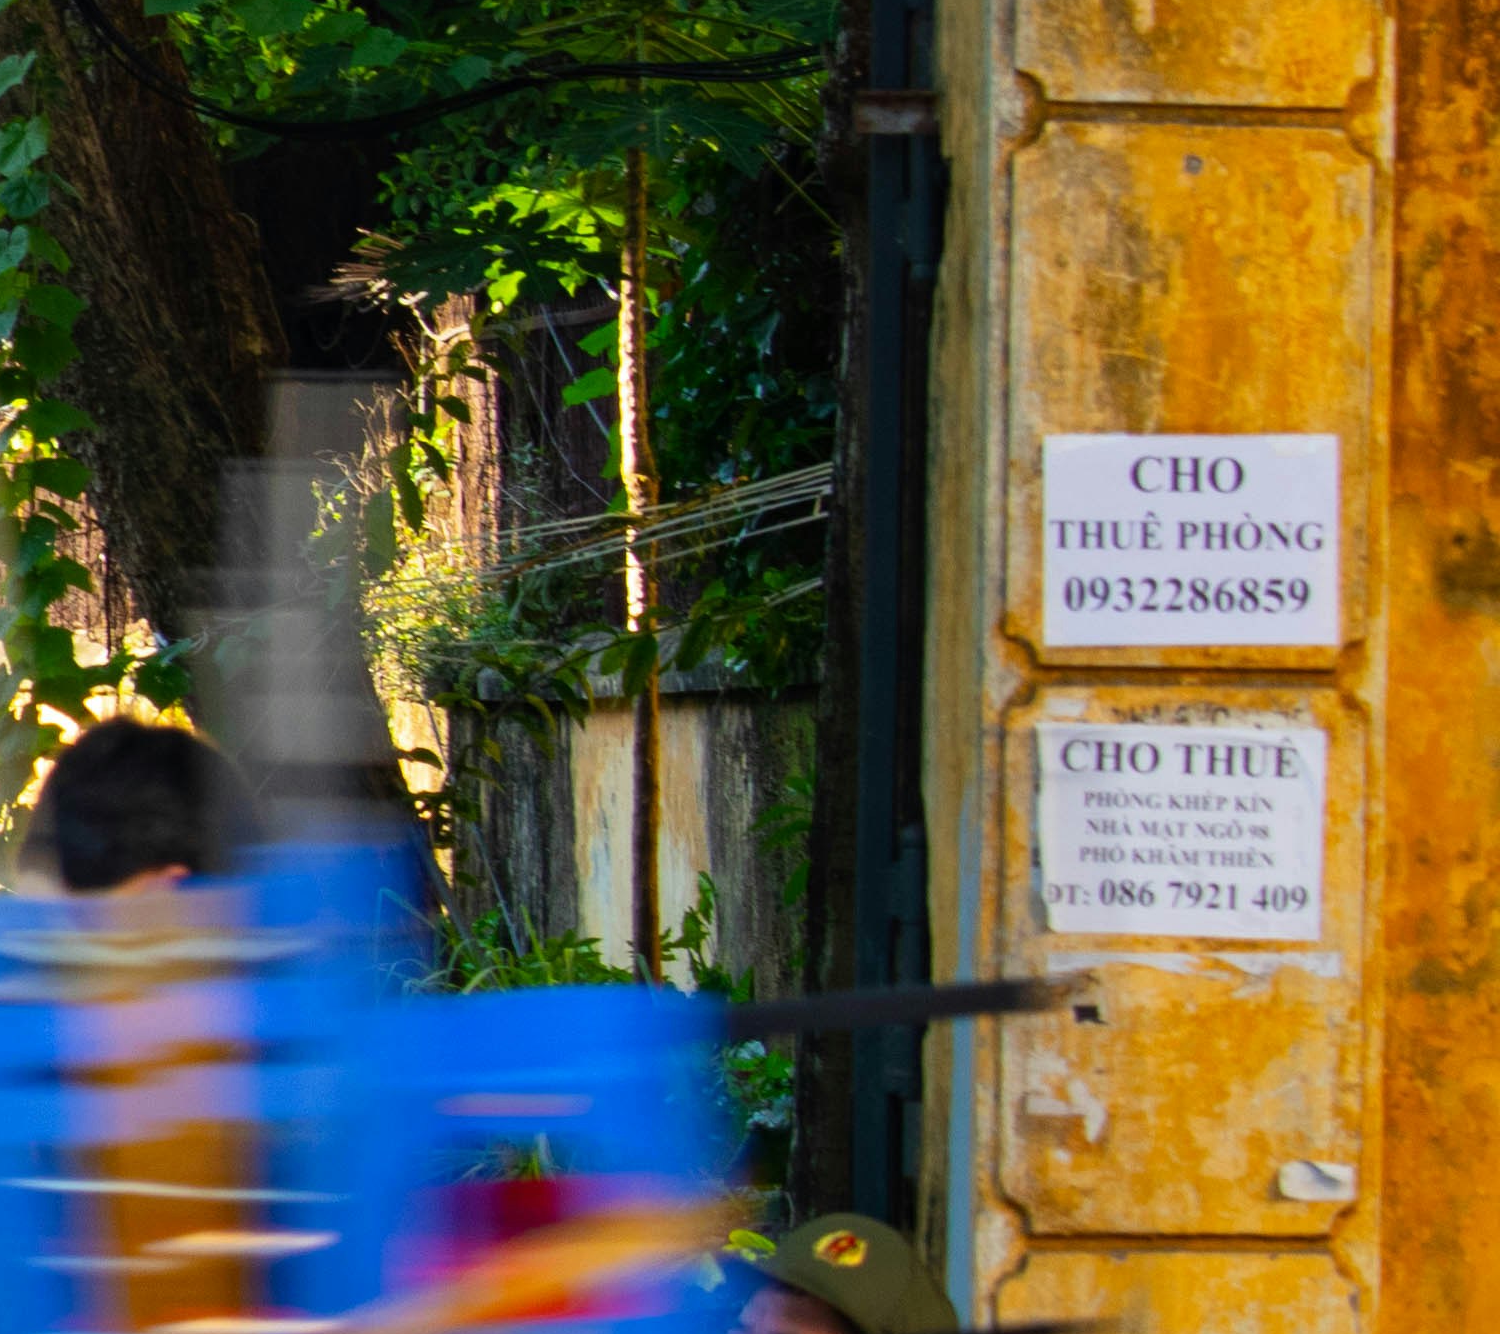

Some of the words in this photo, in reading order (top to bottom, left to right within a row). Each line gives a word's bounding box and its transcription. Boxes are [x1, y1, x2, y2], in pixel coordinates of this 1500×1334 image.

[1129, 454, 1246, 494] CHO
[1050, 509, 1163, 551] THUÊ
[1176, 511, 1325, 552] PHÒNG
[1063, 576, 1312, 615] 0932286859
[1059, 738, 1161, 775] CHO
[1173, 736, 1299, 779] THUÊ
[1099, 877, 1157, 908] 086
[1167, 880, 1239, 910] 7921
[1251, 884, 1311, 913] 409
